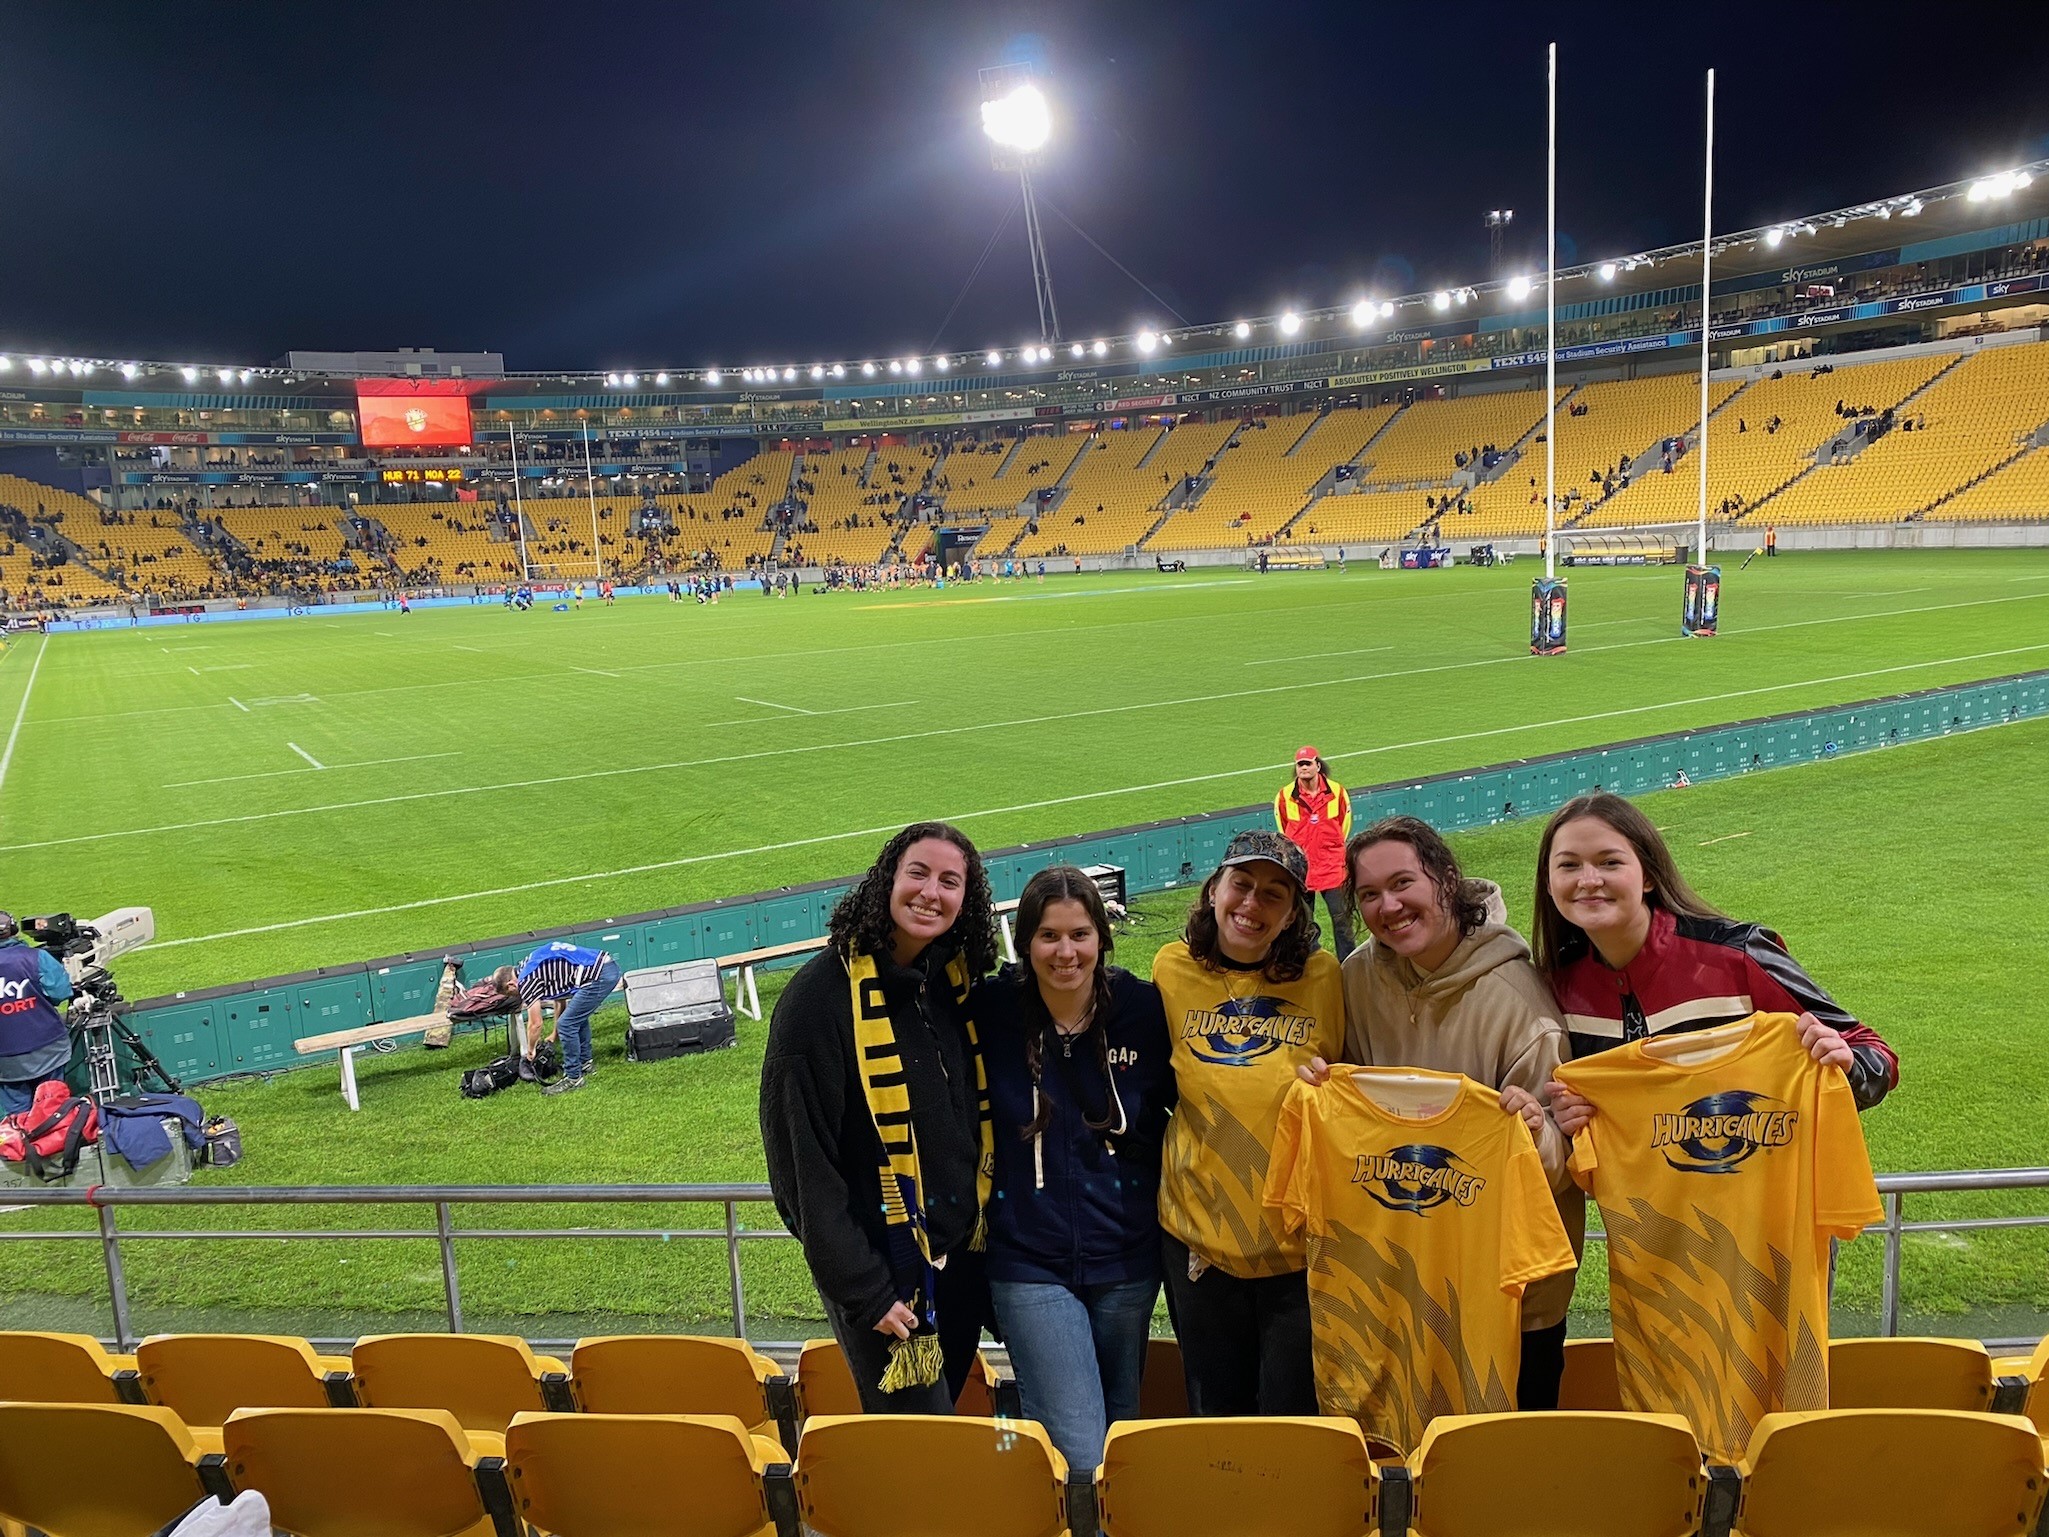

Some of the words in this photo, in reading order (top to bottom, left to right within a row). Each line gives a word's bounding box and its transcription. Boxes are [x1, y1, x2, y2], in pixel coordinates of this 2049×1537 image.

[1803, 266, 1838, 279] STADIUM
[1916, 298, 1943, 307] STADIUM
[1814, 314, 1840, 323] STADIUM
[1404, 331, 1431, 340] STADIUM
[1717, 329, 1741, 338] STADIUM
[1494, 356, 1525, 368] TEXT
[1566, 348, 1595, 358] Stadium
[1595, 344, 1626, 356] Security
[1627, 338, 1667, 351] Assistance
[1073, 371, 1097, 379] STADIUM
[1334, 374, 1377, 386] ABSOLUTELY
[1380, 369, 1418, 381] POSITIVELY
[1421, 364, 1467, 376] WELLINGTON
[1222, 387, 1268, 398] COMMUNITY
[1270, 384, 1294, 392] TRUST
[1131, 399, 1161, 407] SECURITY
[859, 418, 925, 428] WellingtonNZ.com
[15, 432, 46, 440] Stadium
[47, 432, 78, 441] Security
[80, 433, 117, 441] Assistance
[607, 430, 636, 438] TEXT
[638, 429, 661, 437] 5454
[695, 428, 719, 436] Security
[720, 427, 750, 435] Assistance
[383, 470, 403, 480] HUR
[406, 470, 419, 480] 71
[425, 469, 444, 480] MOA
[448, 469, 461, 479] 22
[1181, 1010, 1316, 1046] HURRICANES
[1109, 1047, 1138, 1065] GAP
[1651, 1110, 1799, 1148] HURRICANES
[1351, 1154, 1487, 1207] HURRICANES
